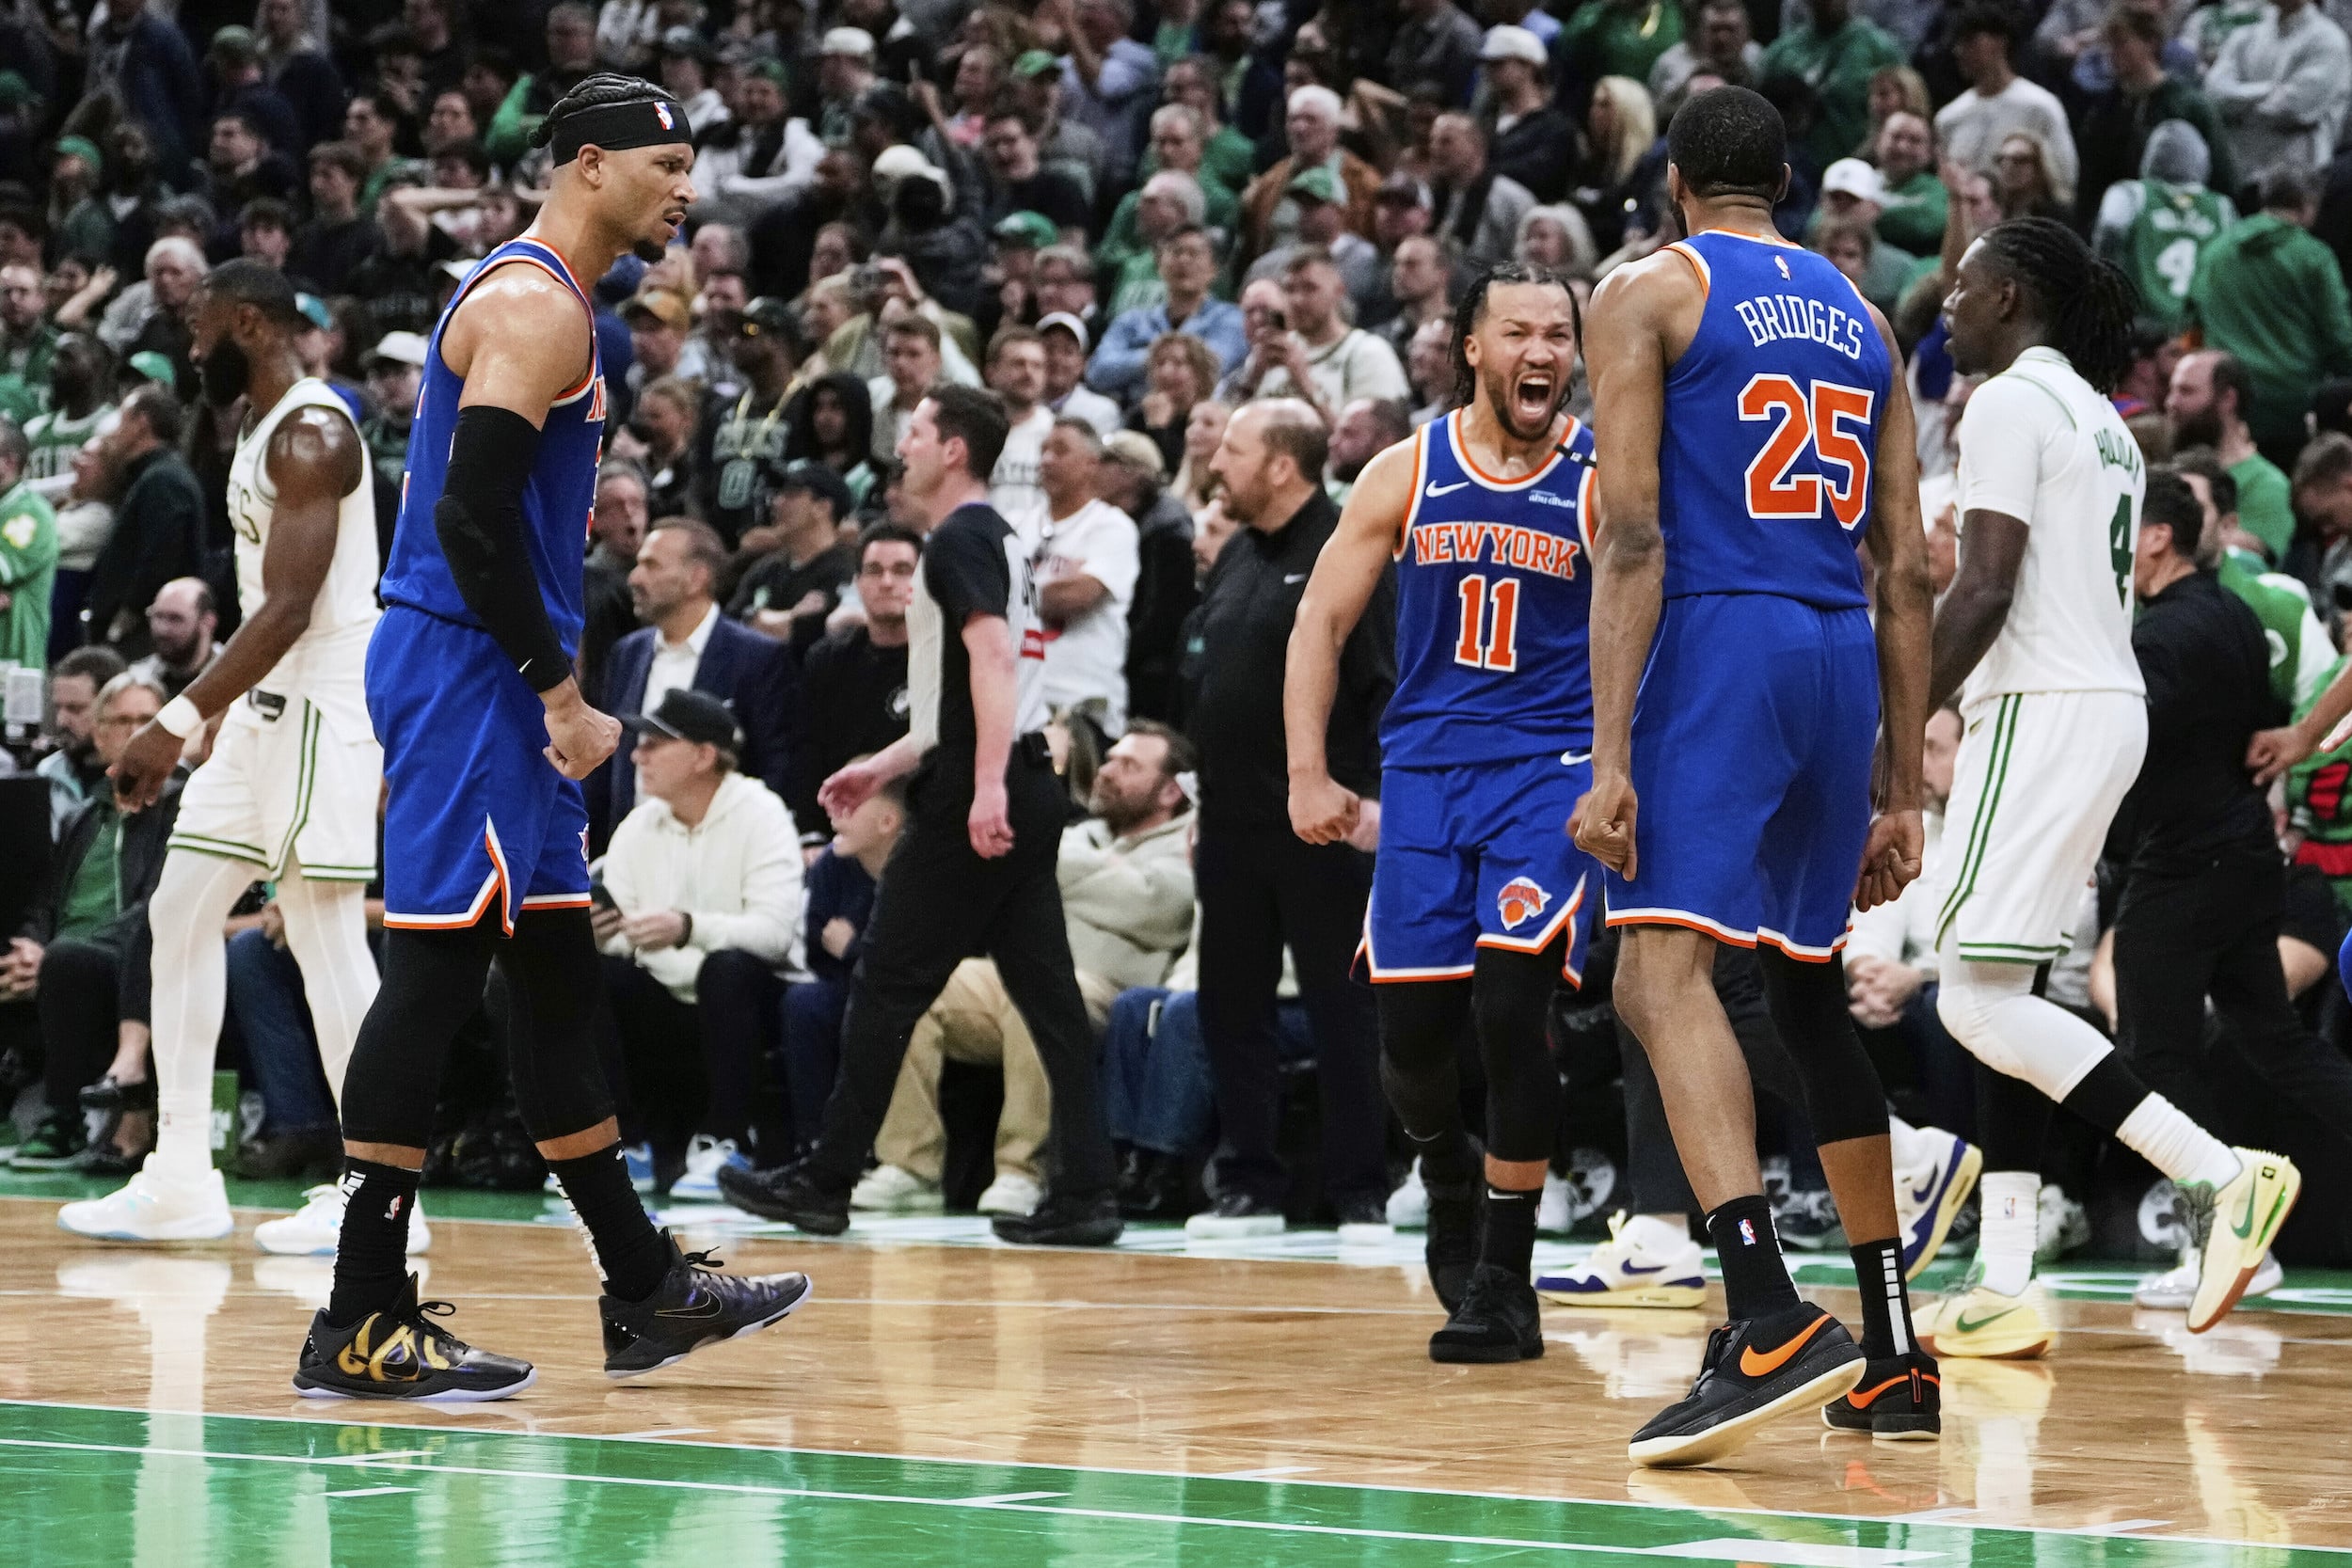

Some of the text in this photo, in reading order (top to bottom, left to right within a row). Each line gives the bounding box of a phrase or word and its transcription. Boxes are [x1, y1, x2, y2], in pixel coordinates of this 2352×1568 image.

[2156, 237, 2198, 298] 4
[1734, 293, 1864, 360] BRIDGES
[1737, 372, 1875, 531] 25
[1412, 521, 1581, 581] NEW YORK
[2109, 492, 2134, 611] 4
[1454, 573, 1521, 673] 11
